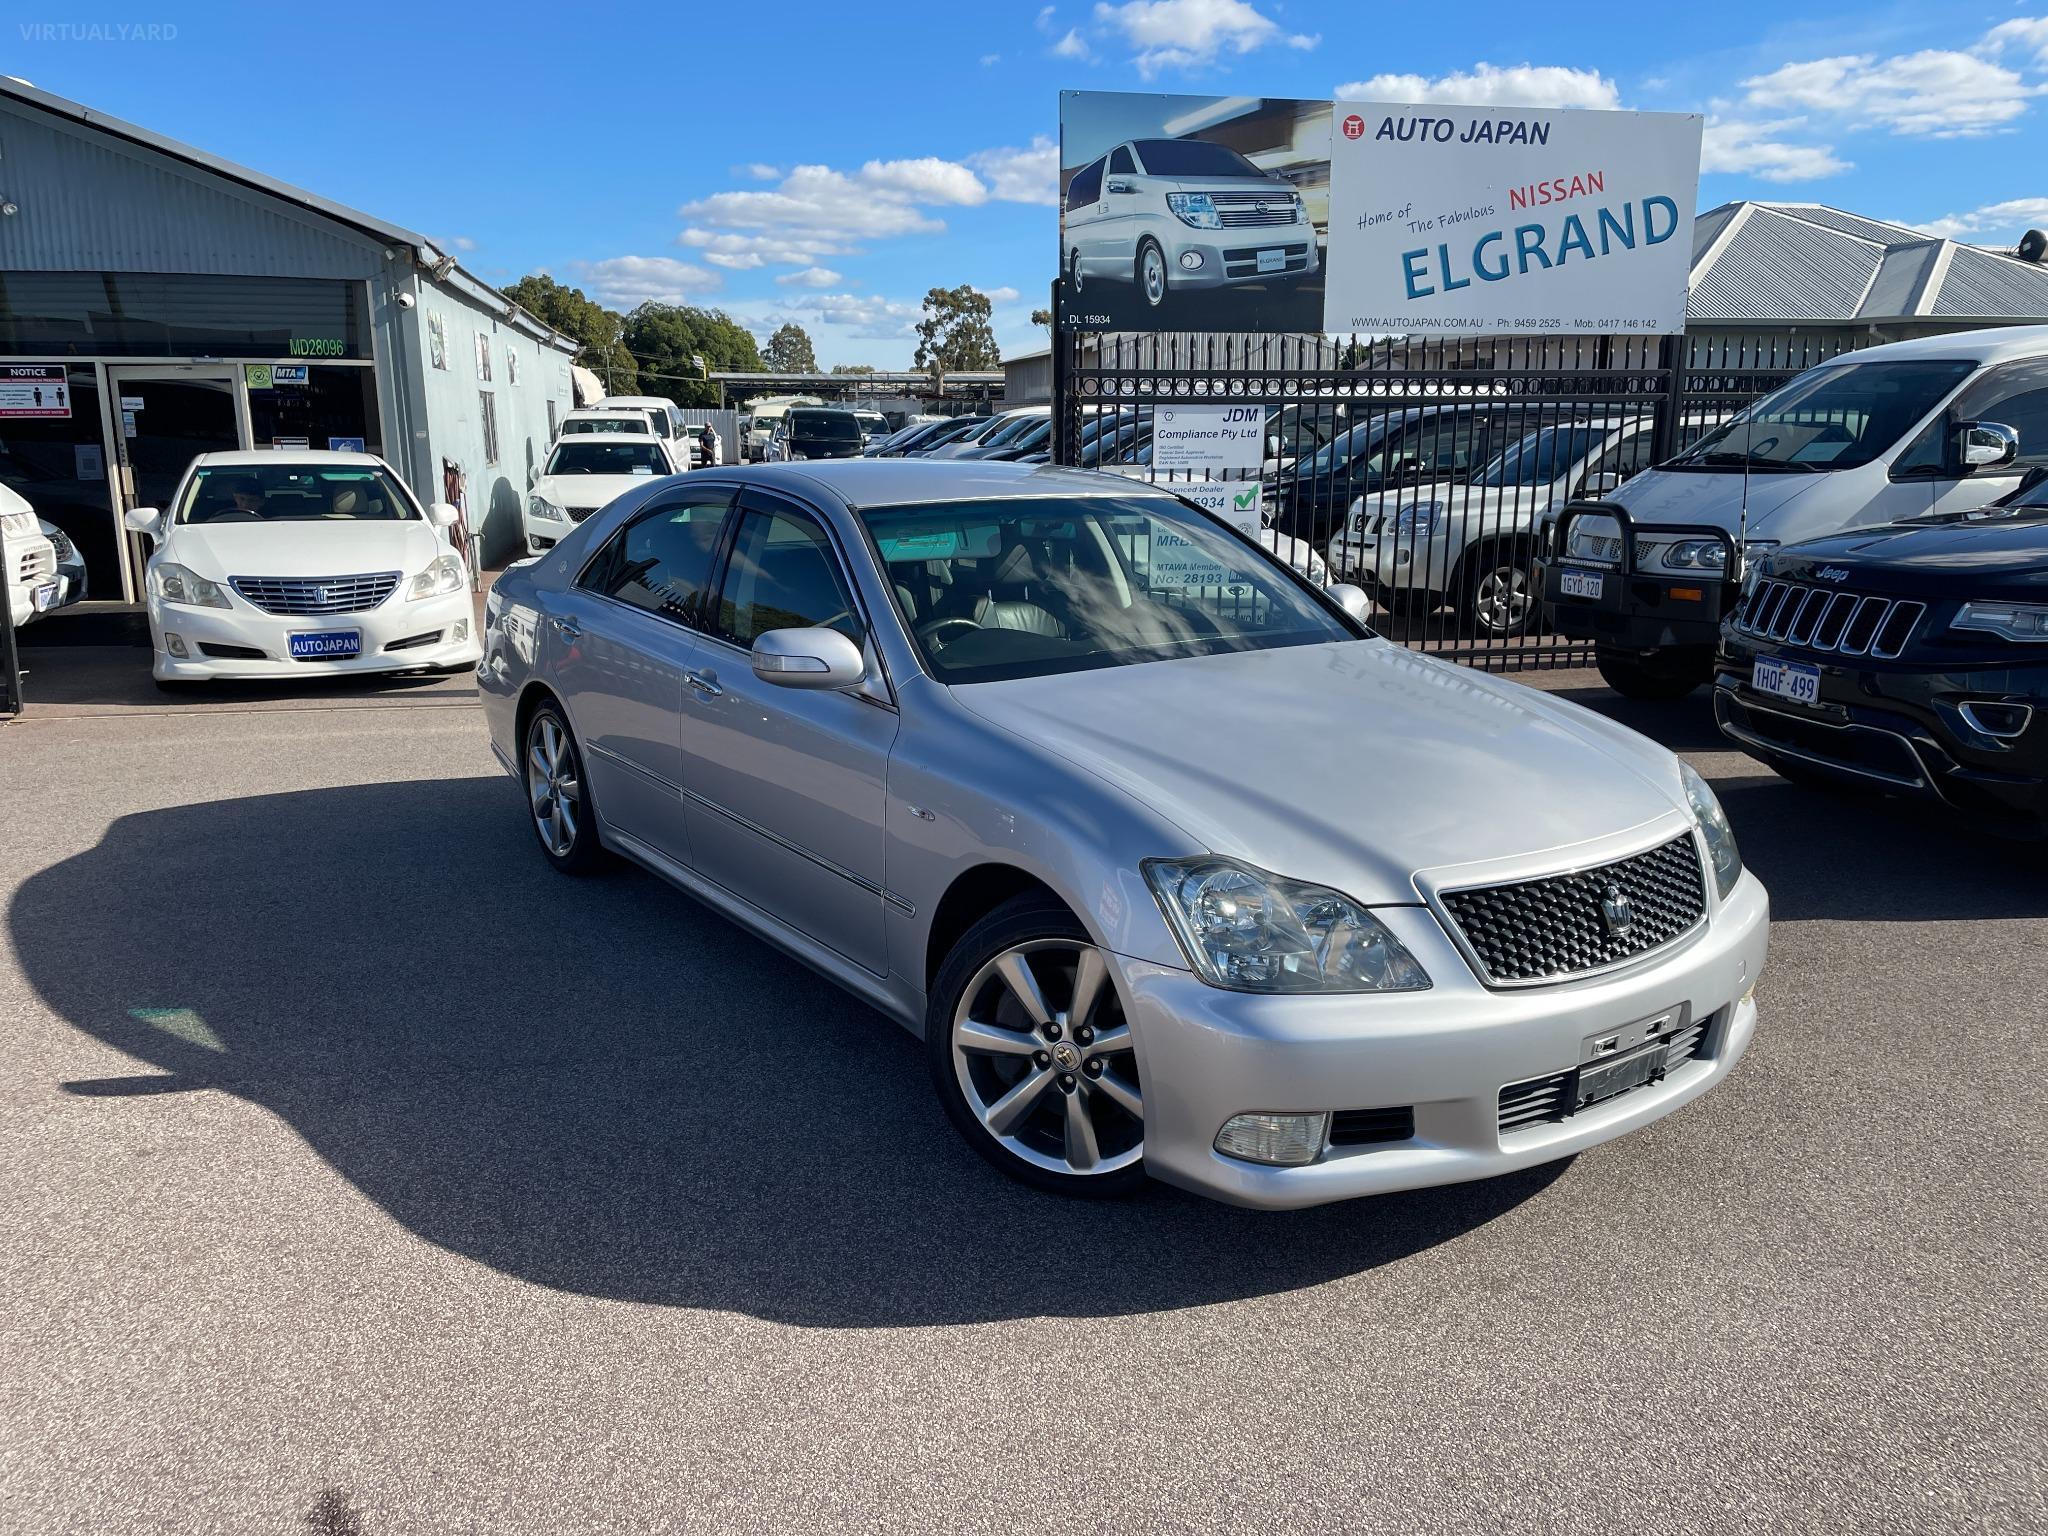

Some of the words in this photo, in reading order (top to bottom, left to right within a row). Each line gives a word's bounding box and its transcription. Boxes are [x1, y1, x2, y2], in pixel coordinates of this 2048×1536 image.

[1375, 117, 1455, 143] AUTO
[1460, 119, 1550, 145] JAPAN
[1510, 171, 1605, 210] NISSAN
[1357, 211, 1393, 231] Home
[1397, 202, 1412, 219] of
[1406, 221, 1434, 234] The
[1437, 204, 1495, 229] Fabulous
[1401, 195, 1679, 300] ELGRAND
[1069, 314, 1082, 324] DL
[1084, 314, 1111, 324] 15934
[1351, 317, 1484, 328] WWW.AUTOJAPAN.COM.AU
[1497, 318, 1512, 328] Ph:
[1514, 318, 1537, 328] 9459
[1538, 318, 1561, 328] 2525
[1574, 319, 1596, 328] Mob:
[1598, 319, 1620, 328] 0417
[1622, 319, 1639, 328] 146
[1641, 319, 1657, 328] 142
[289, 338, 344, 356] MD28096
[10, 368, 47, 377] NOTICE
[276, 368, 297, 378] MTA
[1222, 408, 1259, 422] JDM
[1158, 429, 1219, 440] Compliance
[1221, 429, 1238, 440] Pty
[1240, 428, 1258, 438] Ltd
[1199, 485, 1225, 493] Dealer
[1156, 563, 1188, 571] MTAWA
[1189, 563, 1222, 571] Member
[1816, 565, 1850, 583] Jeep
[1155, 573, 1179, 585] No:
[1183, 573, 1223, 584] 28193
[293, 638, 359, 653] AUTOJAPAN
